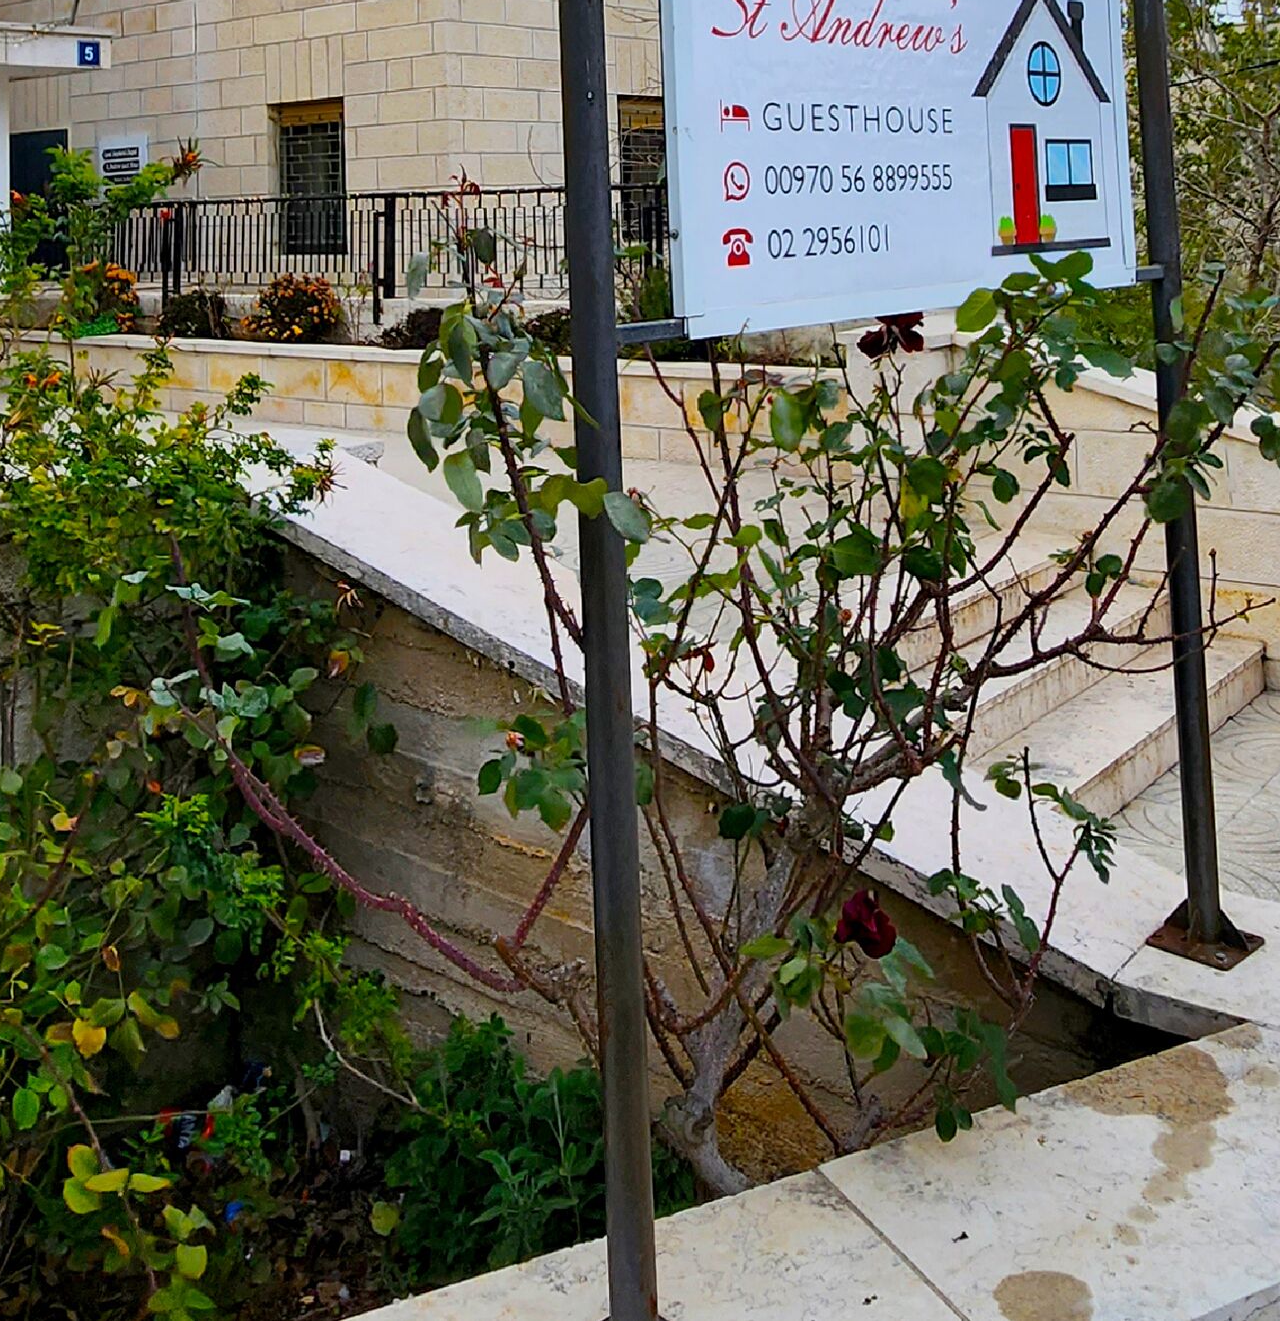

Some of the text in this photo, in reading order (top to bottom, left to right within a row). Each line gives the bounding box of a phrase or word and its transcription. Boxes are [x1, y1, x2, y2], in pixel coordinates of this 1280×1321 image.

[84, 46, 94, 62] 5
[762, 102, 954, 134] GUESTHOUSE
[764, 163, 953, 195] 00970 56 8899555
[767, 223, 890, 260] 02 2956101
